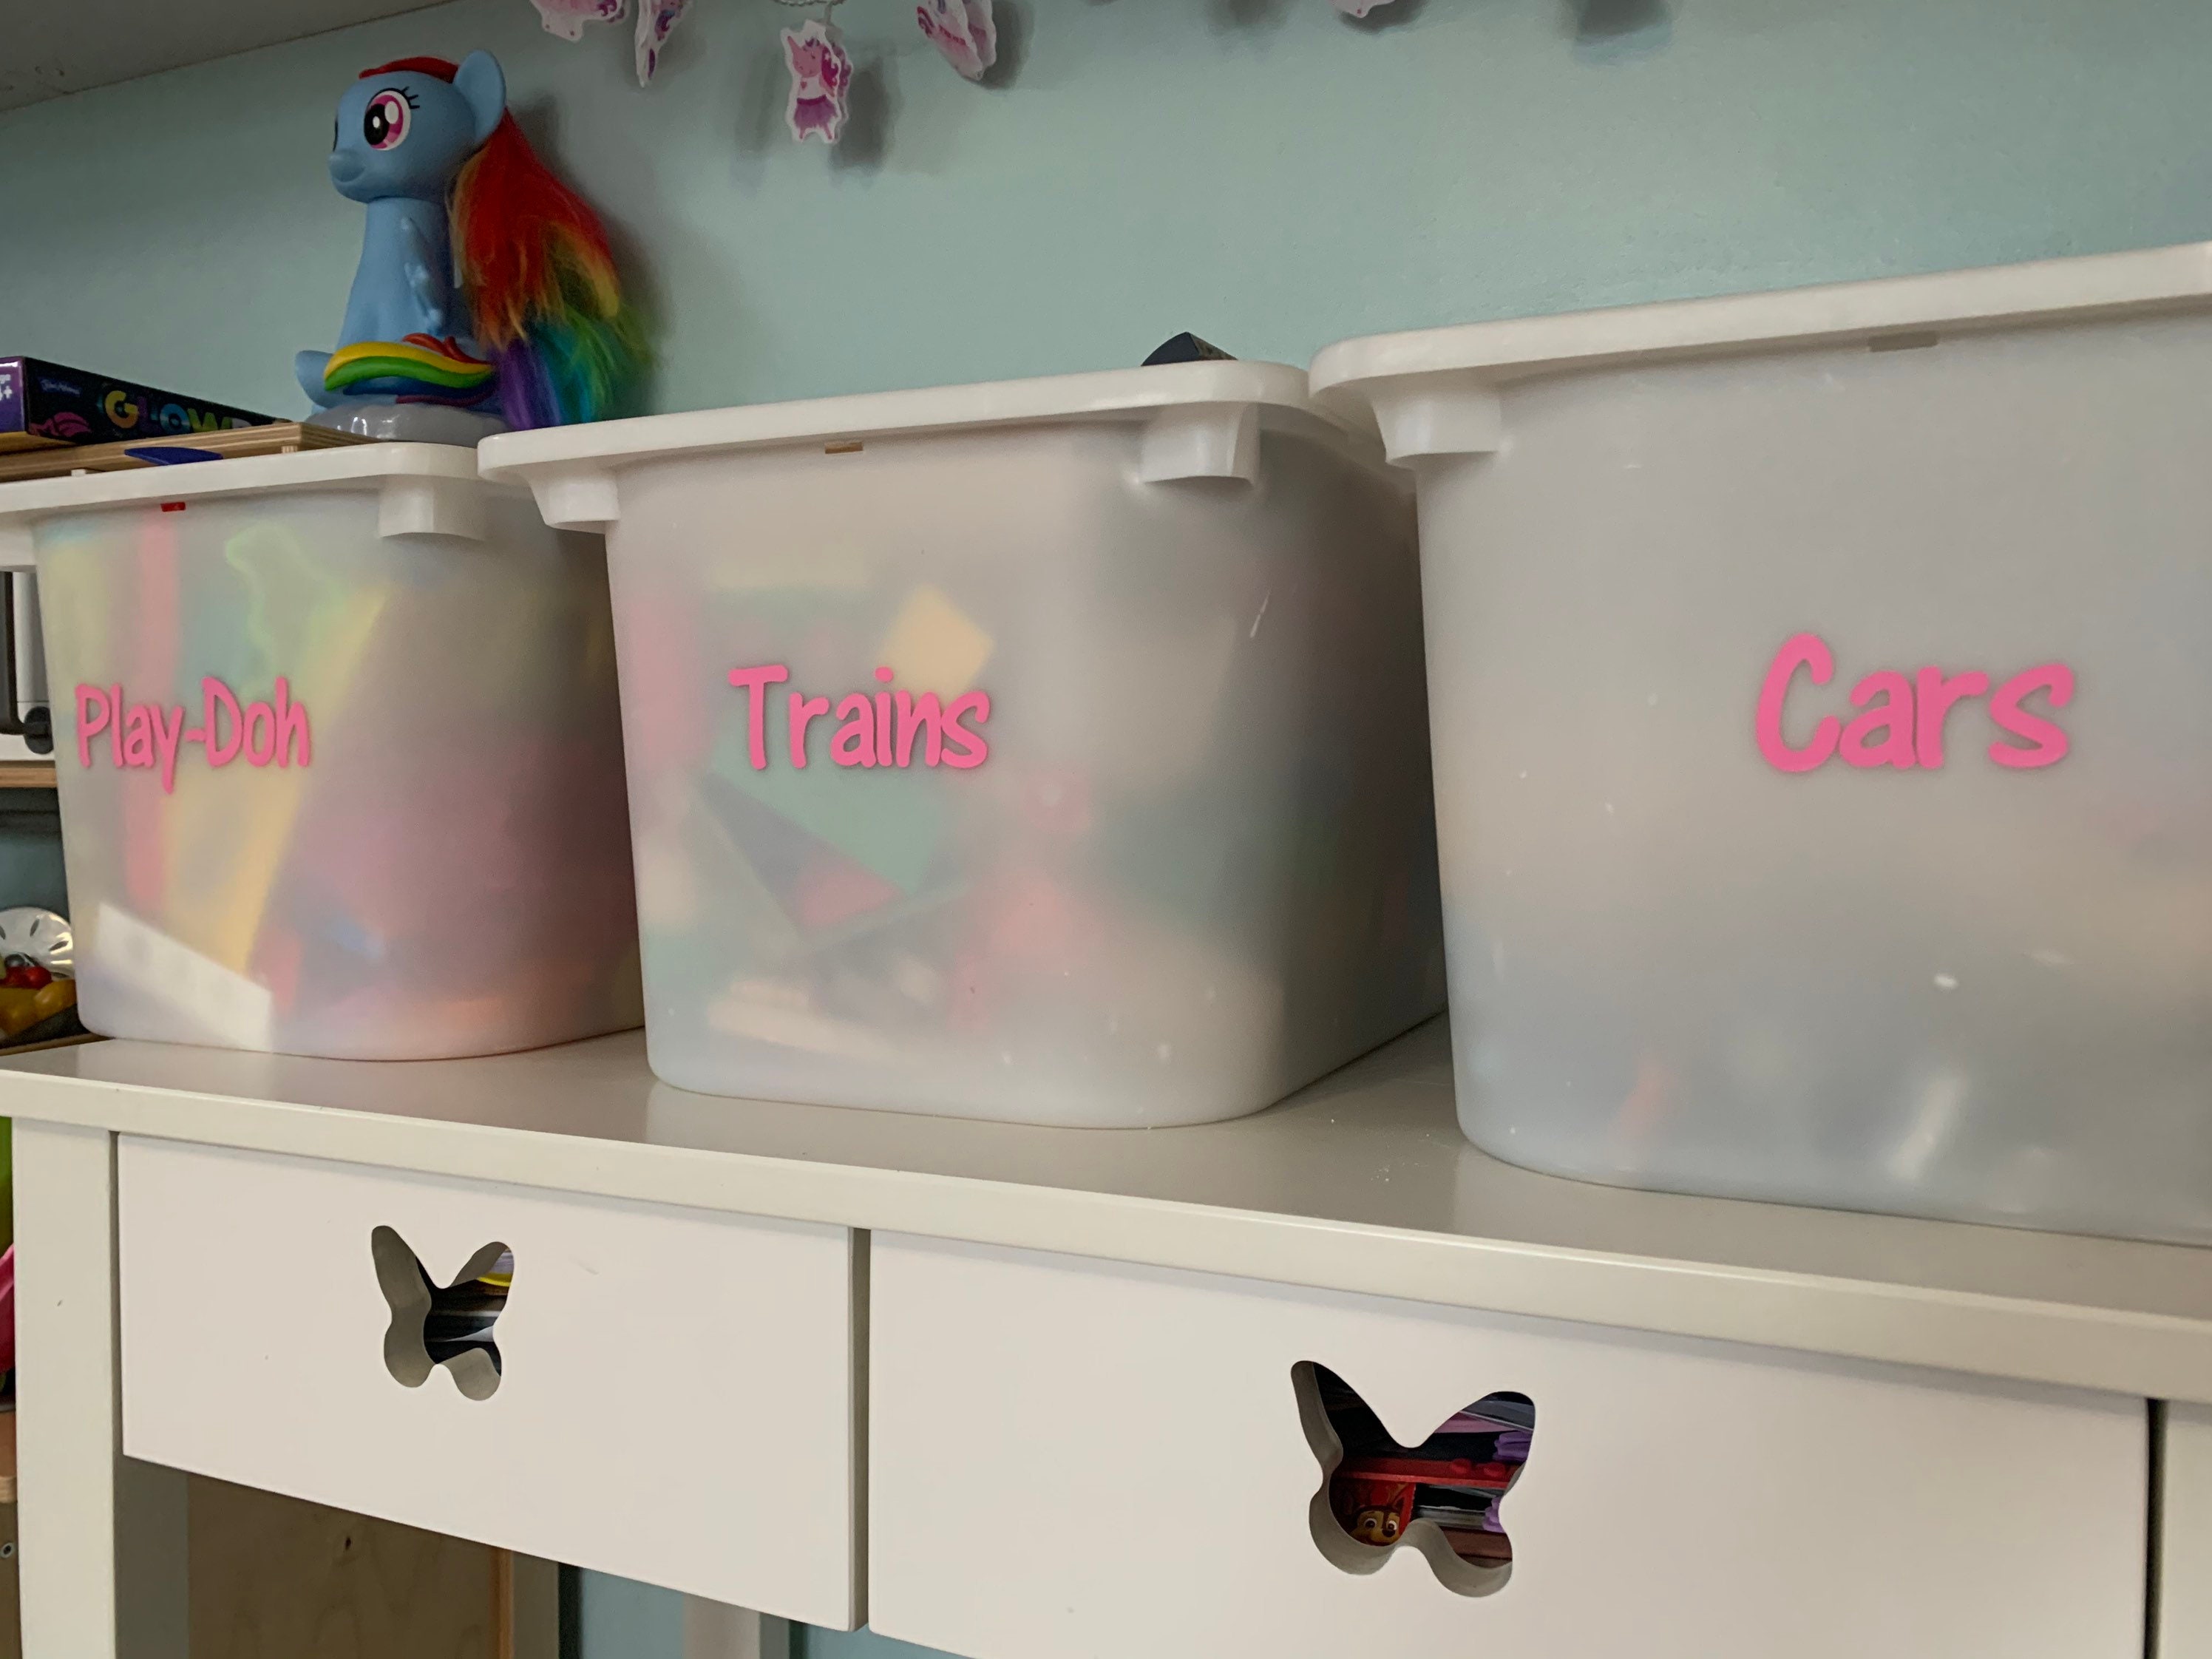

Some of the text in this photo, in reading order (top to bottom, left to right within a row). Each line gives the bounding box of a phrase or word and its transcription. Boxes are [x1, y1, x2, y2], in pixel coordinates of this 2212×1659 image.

[76, 676, 311, 793] Play-Doh
[728, 665, 991, 770] Trains
[1756, 633, 2075, 773] Cars
